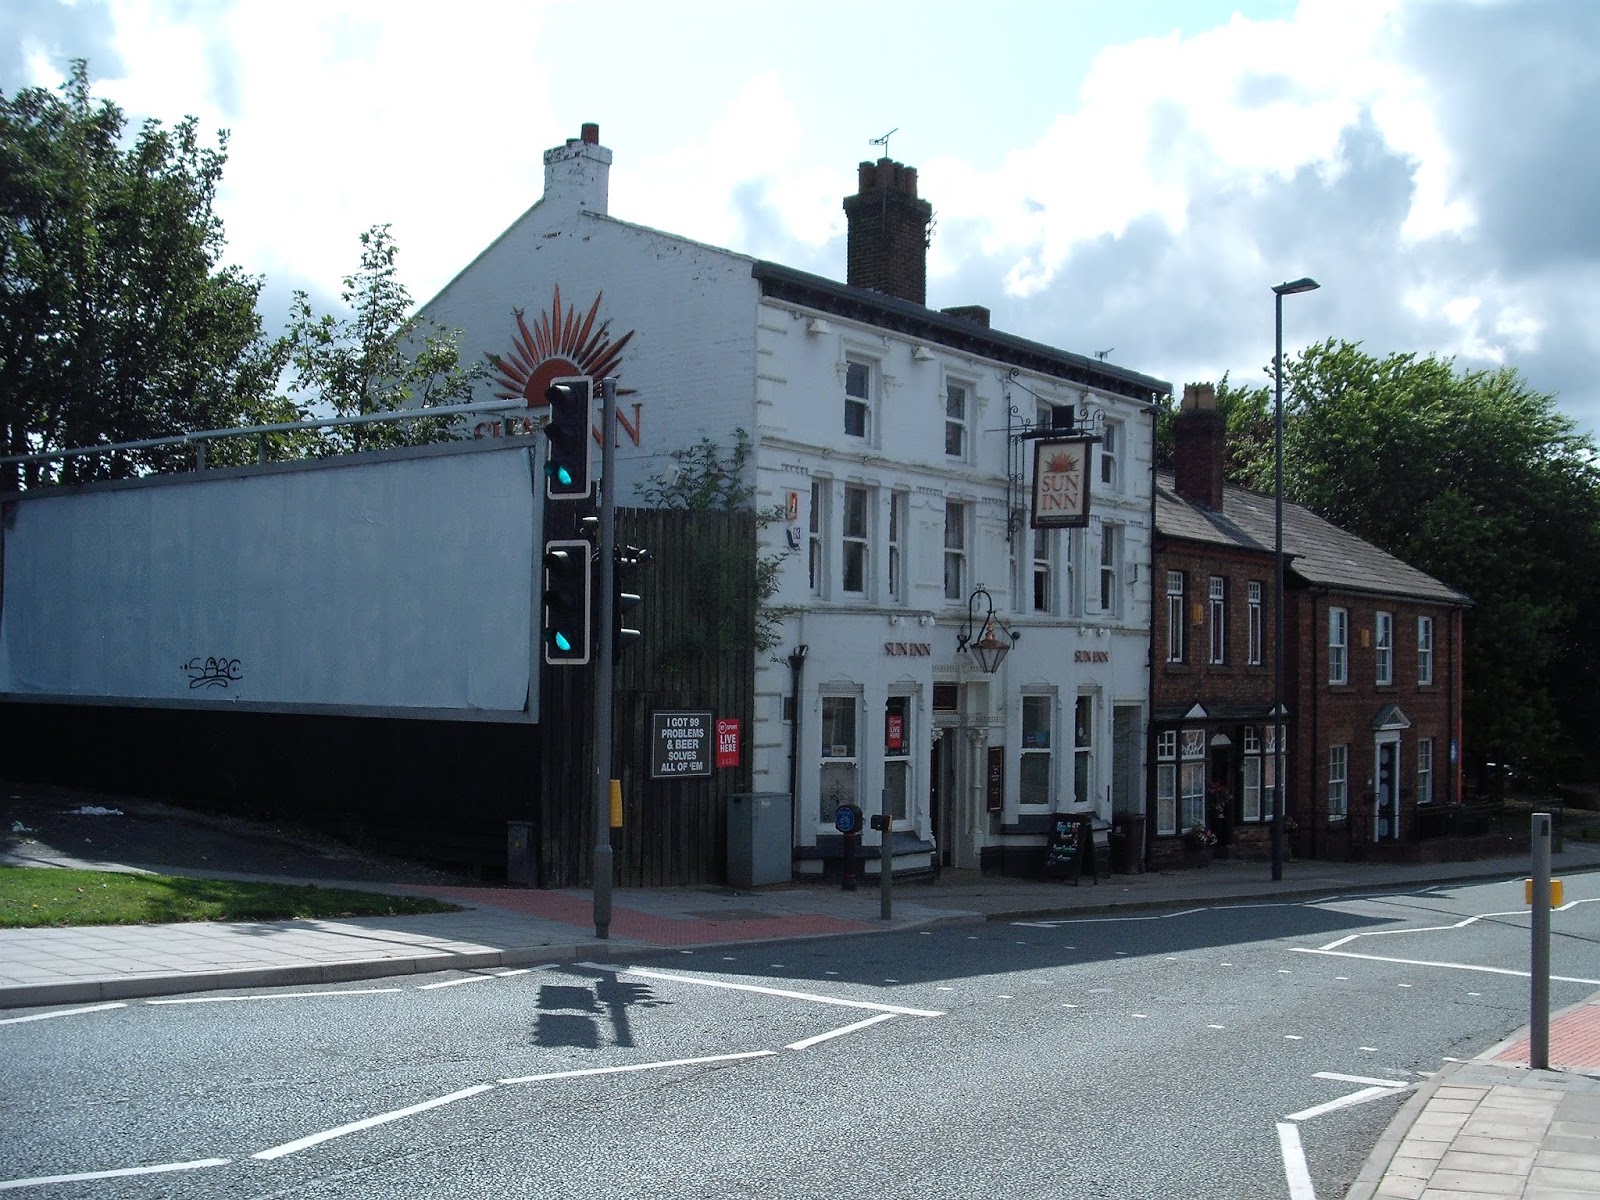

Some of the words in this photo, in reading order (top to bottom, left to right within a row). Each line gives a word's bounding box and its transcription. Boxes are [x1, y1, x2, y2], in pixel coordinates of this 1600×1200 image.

[1042, 474, 1080, 492] SUN
[1042, 492, 1078, 510] INN
[884, 642, 908, 656] SUN
[909, 643, 931, 657] INN
[1074, 650, 1091, 663] SUN
[1092, 651, 1109, 663] INN
[671, 717, 688, 727] GOT
[689, 717, 700, 727] 99
[661, 728, 704, 738] PROBLEMS
[666, 739, 673, 749] &
[675, 739, 699, 749] BEER
[720, 734, 736, 744] LIVE
[720, 743, 736, 753] HERE
[668, 751, 697, 761] SOLVES
[661, 762, 676, 772] ALL
[677, 762, 688, 771] OF
